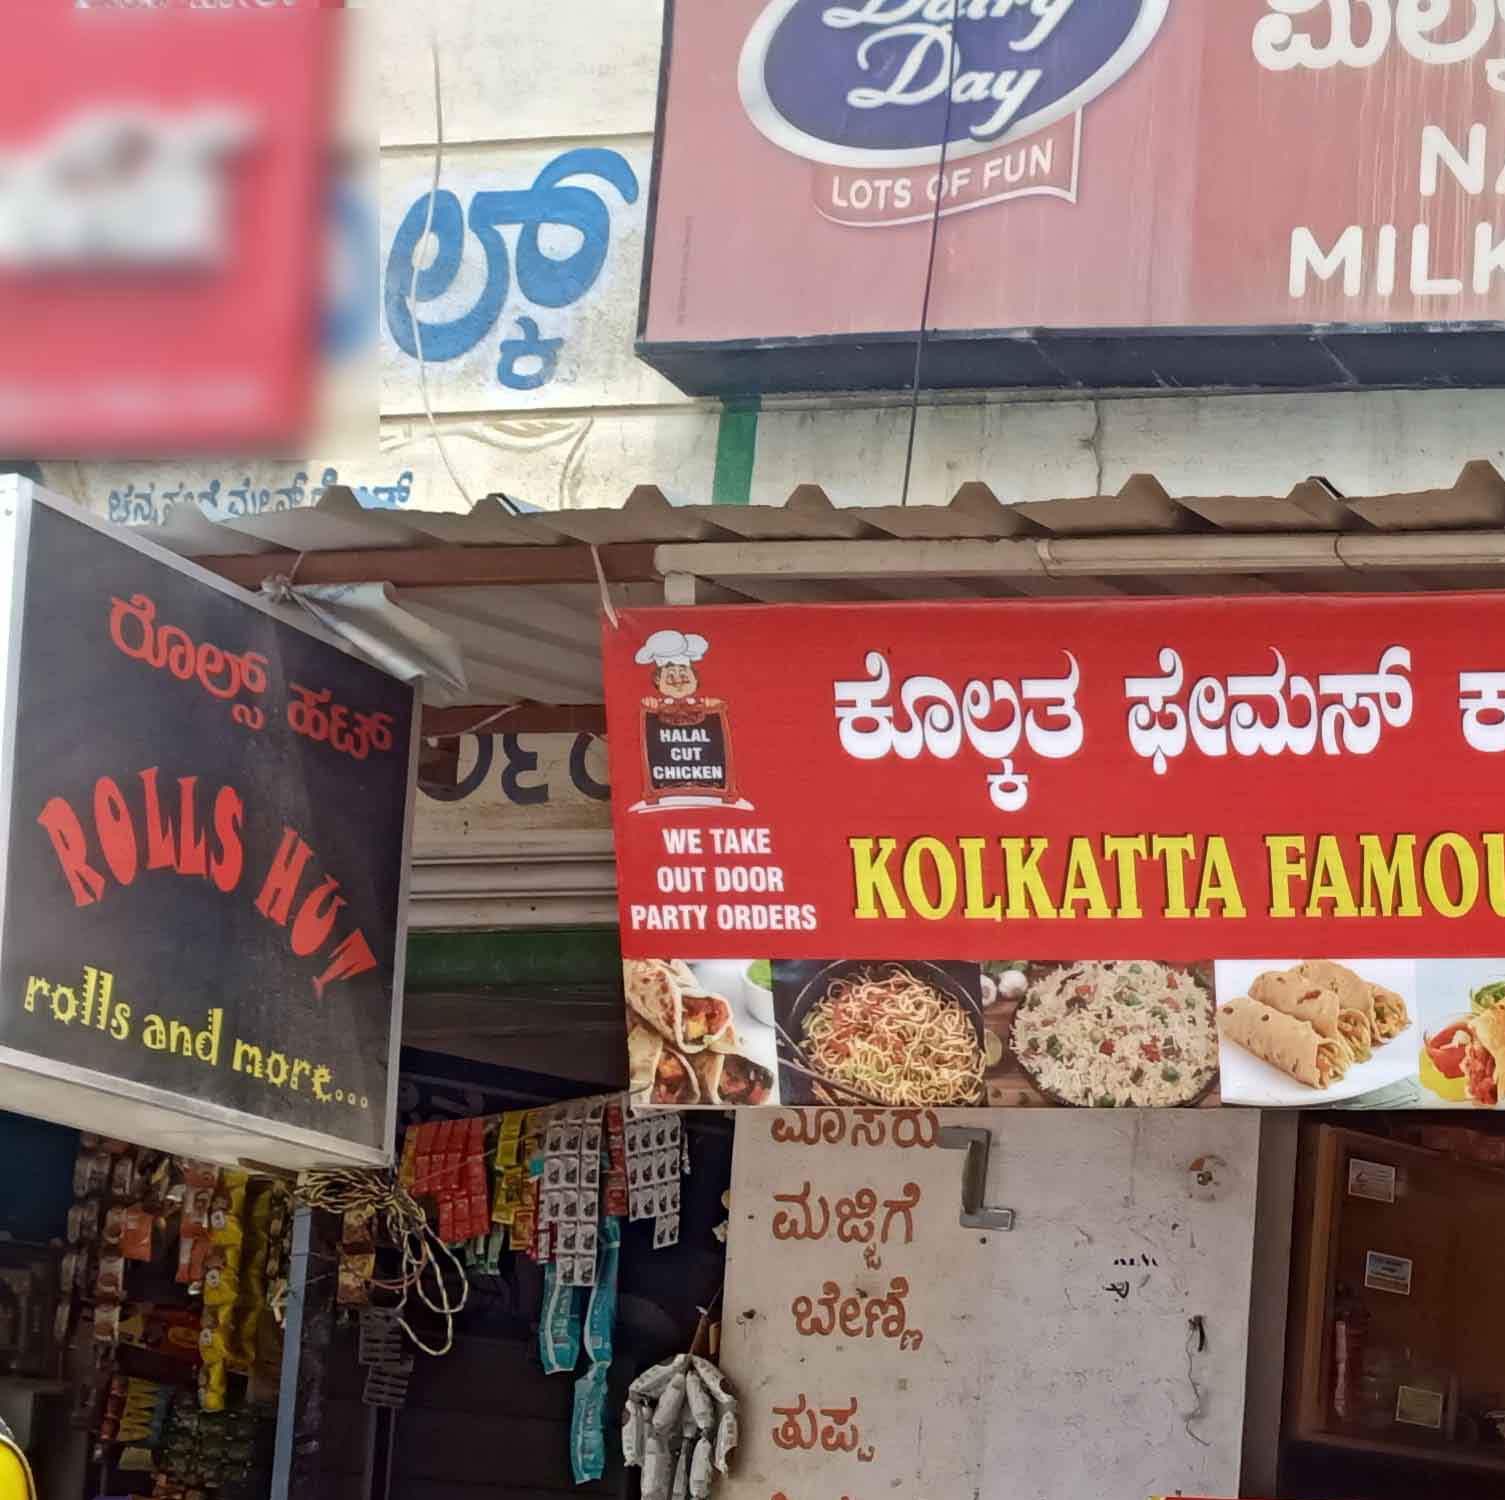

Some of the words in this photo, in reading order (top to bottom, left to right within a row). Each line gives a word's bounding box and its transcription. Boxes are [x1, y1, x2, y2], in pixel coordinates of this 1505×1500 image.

[847, 23, 1042, 136] Day
[832, 176, 911, 209] LOTS
[926, 168, 971, 201] OF
[983, 139, 1053, 189] FUN
[659, 728, 711, 743] HALAL
[670, 746, 703, 761] CUT
[832, 647, 1085, 812] ಕೊಲ್ಕತ
[1123, 645, 1414, 774] ಫೇಮಸ್
[652, 765, 723, 780] CHICKEN
[662, 828, 703, 854] WE
[709, 828, 771, 854] TAKE
[38, 766, 246, 908] ROLLS
[254, 827, 379, 1000] HUT
[657, 866, 706, 893] OUT
[714, 866, 785, 893] DOOR
[848, 836, 1247, 922] KOLKATTA
[630, 904, 708, 930] PARTY
[717, 904, 817, 930] ORDERS
[22, 964, 132, 1041] rolls
[142, 1008, 224, 1066] and
[772, 1181, 921, 1270] ಮಜ್ಜಿಗೆ
[771, 1393, 875, 1462] ತುಪ್ಪ
